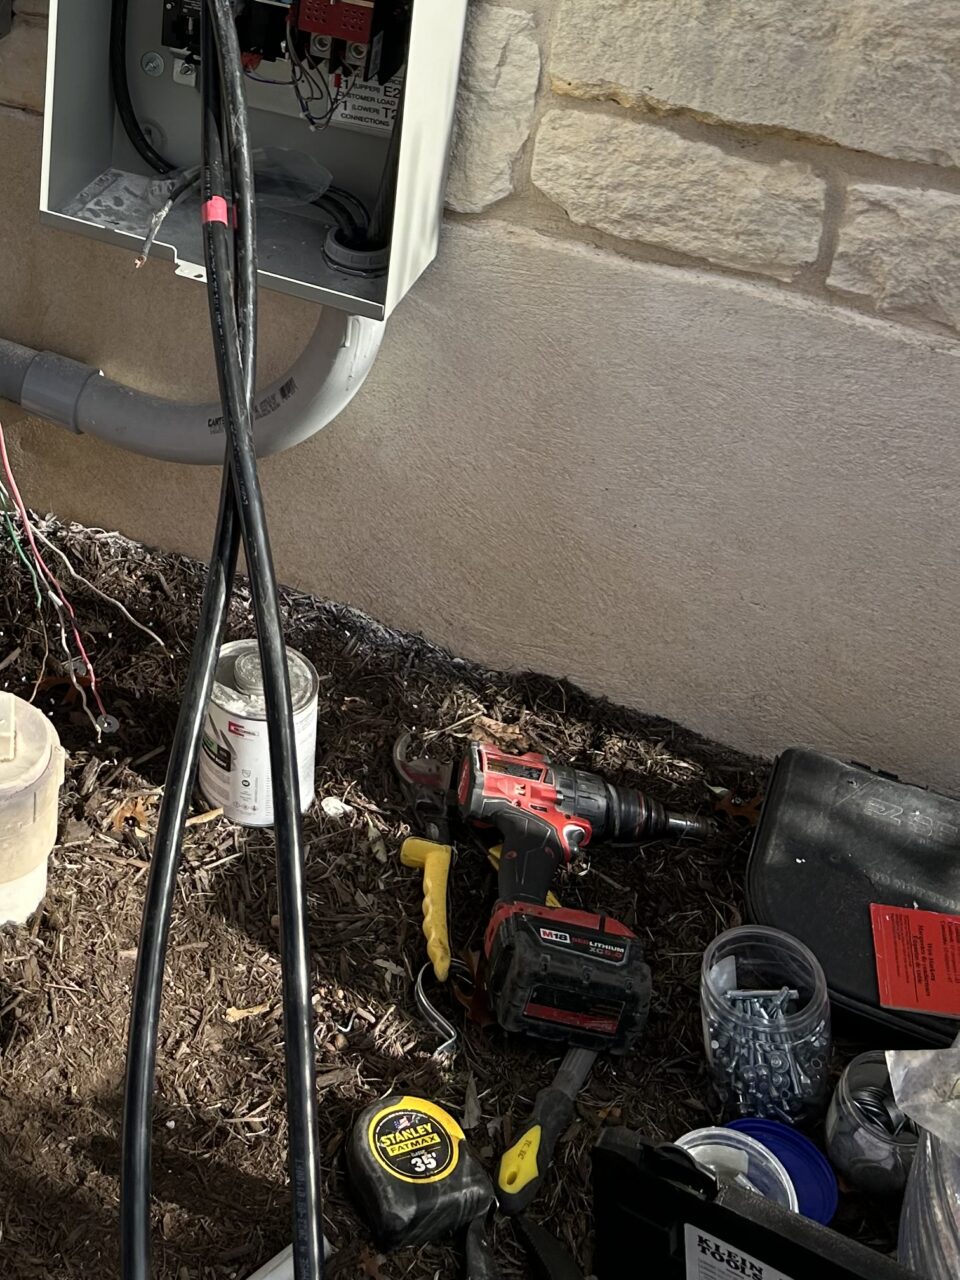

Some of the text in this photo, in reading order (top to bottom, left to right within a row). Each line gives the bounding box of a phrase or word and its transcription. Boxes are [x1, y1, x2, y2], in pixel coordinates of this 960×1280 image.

[383, 86, 401, 99] E2
[340, 113, 390, 127] CONNECTIONS
[542, 930, 567, 941] M18
[380, 1123, 433, 1146] STANLEY
[390, 1135, 437, 1154] FATMAX
[411, 1152, 437, 1172] 35'
[697, 1235, 764, 1275] KLEIN
